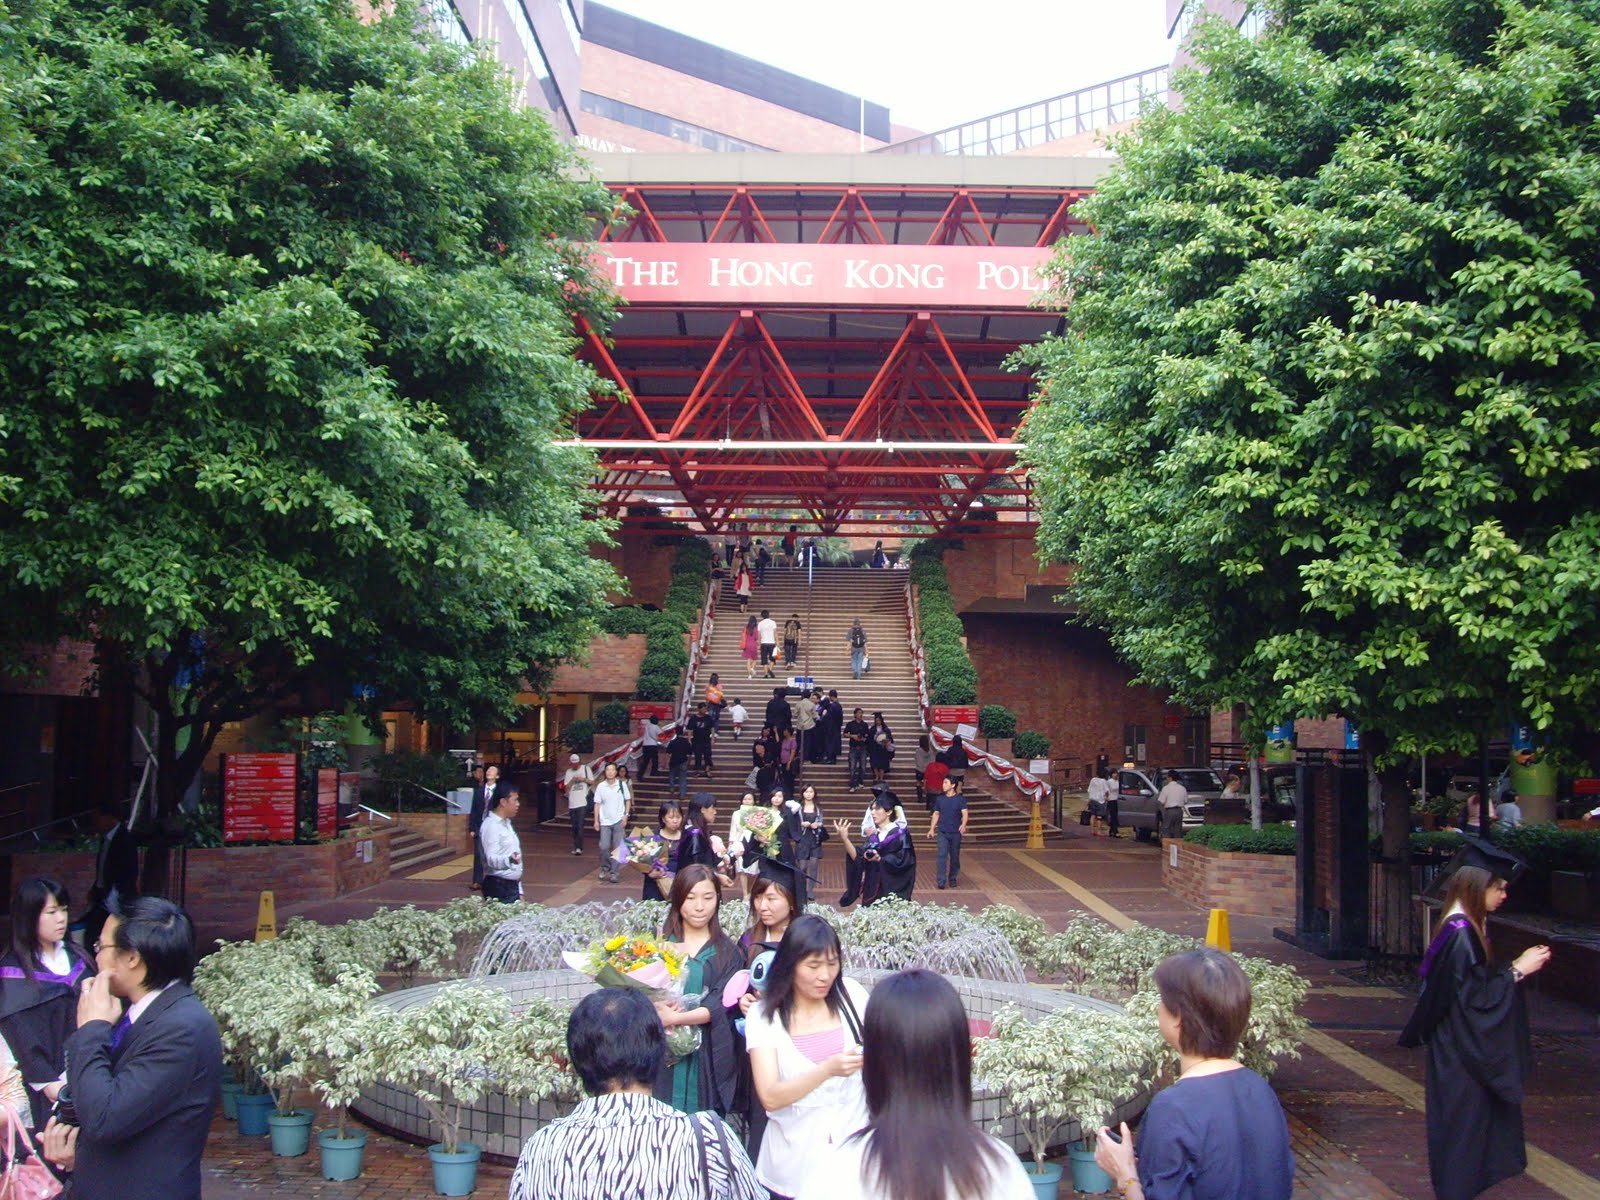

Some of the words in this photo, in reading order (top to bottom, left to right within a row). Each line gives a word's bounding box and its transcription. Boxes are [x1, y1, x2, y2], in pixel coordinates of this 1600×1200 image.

[606, 257, 679, 286] THE
[708, 257, 814, 287] HONG
[844, 259, 945, 289] KONG
